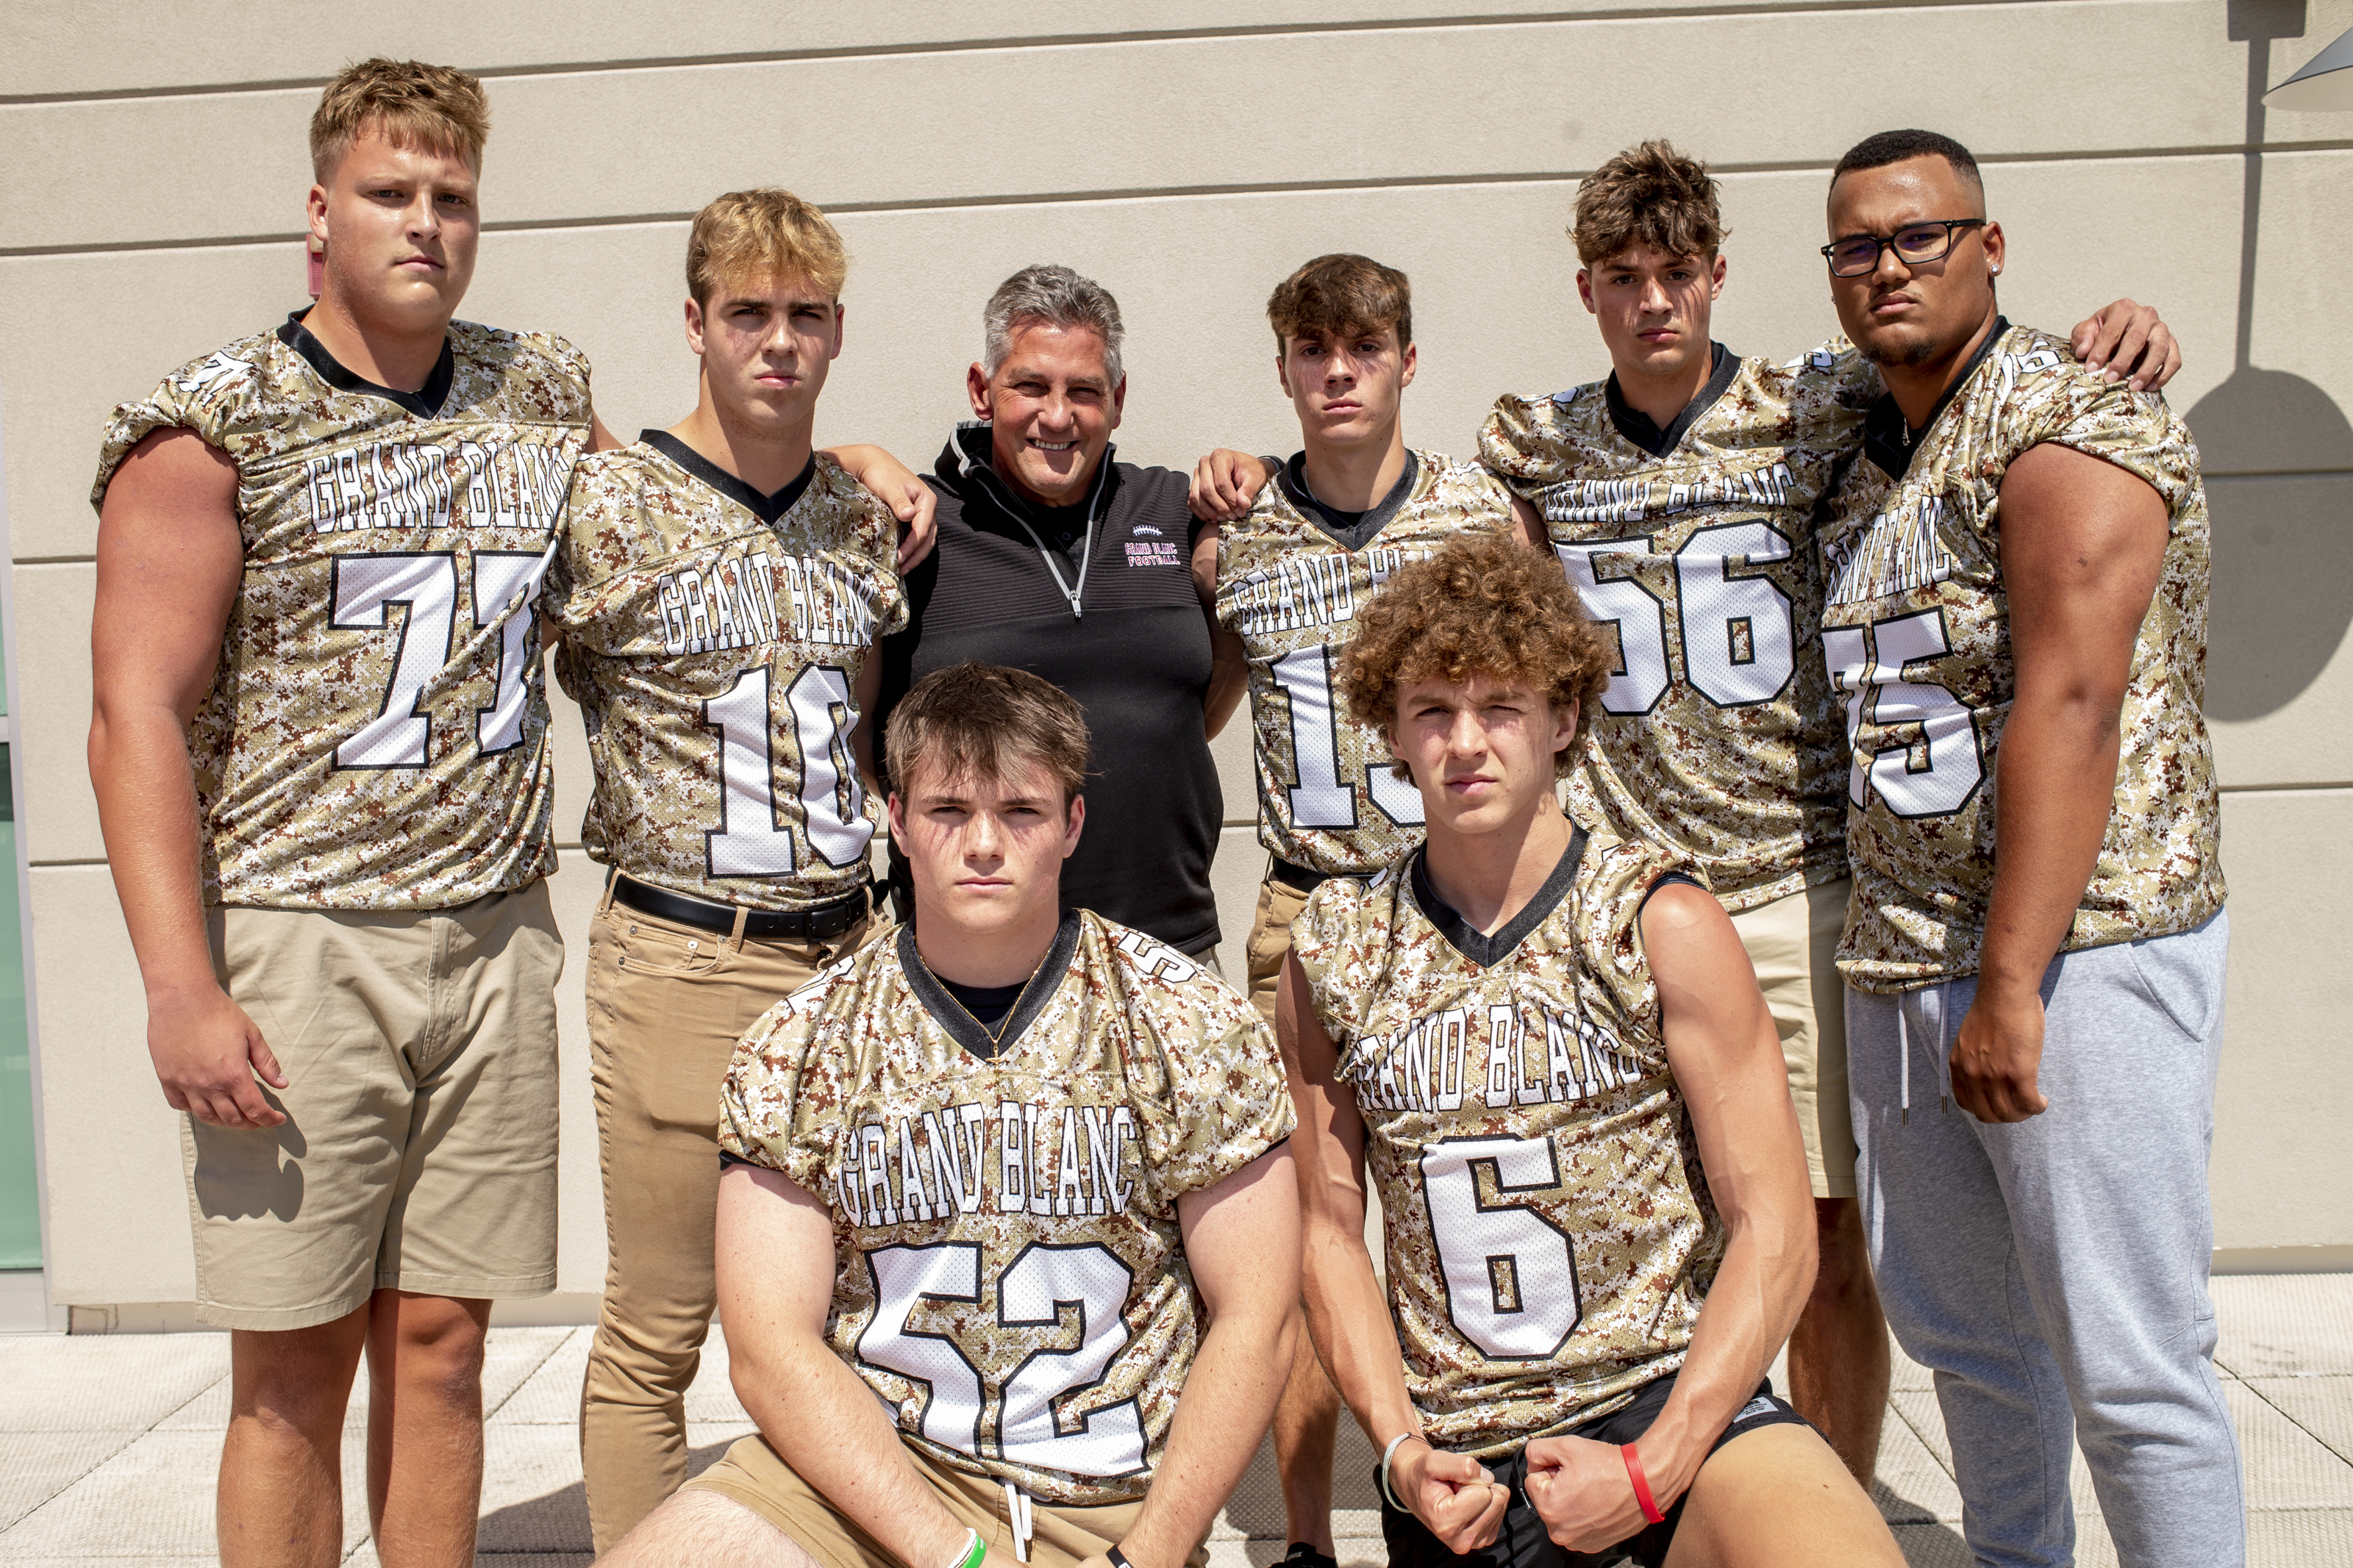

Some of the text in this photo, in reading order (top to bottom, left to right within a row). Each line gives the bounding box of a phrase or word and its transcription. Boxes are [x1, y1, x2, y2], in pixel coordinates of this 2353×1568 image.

[306, 443, 453, 534] GRAND
[1125, 543, 1178, 555] GRAND BLANC
[657, 551, 779, 656] GRAND
[1128, 555, 1181, 567] FOOTBALL
[1230, 552, 1355, 637] GRAND
[1552, 518, 1799, 717] 56
[327, 550, 555, 771] 77
[702, 662, 880, 880] 10
[836, 1100, 1138, 1228] GRAND BLANC
[1418, 1132, 1584, 1362] 6
[857, 1240, 1152, 1480] 52
